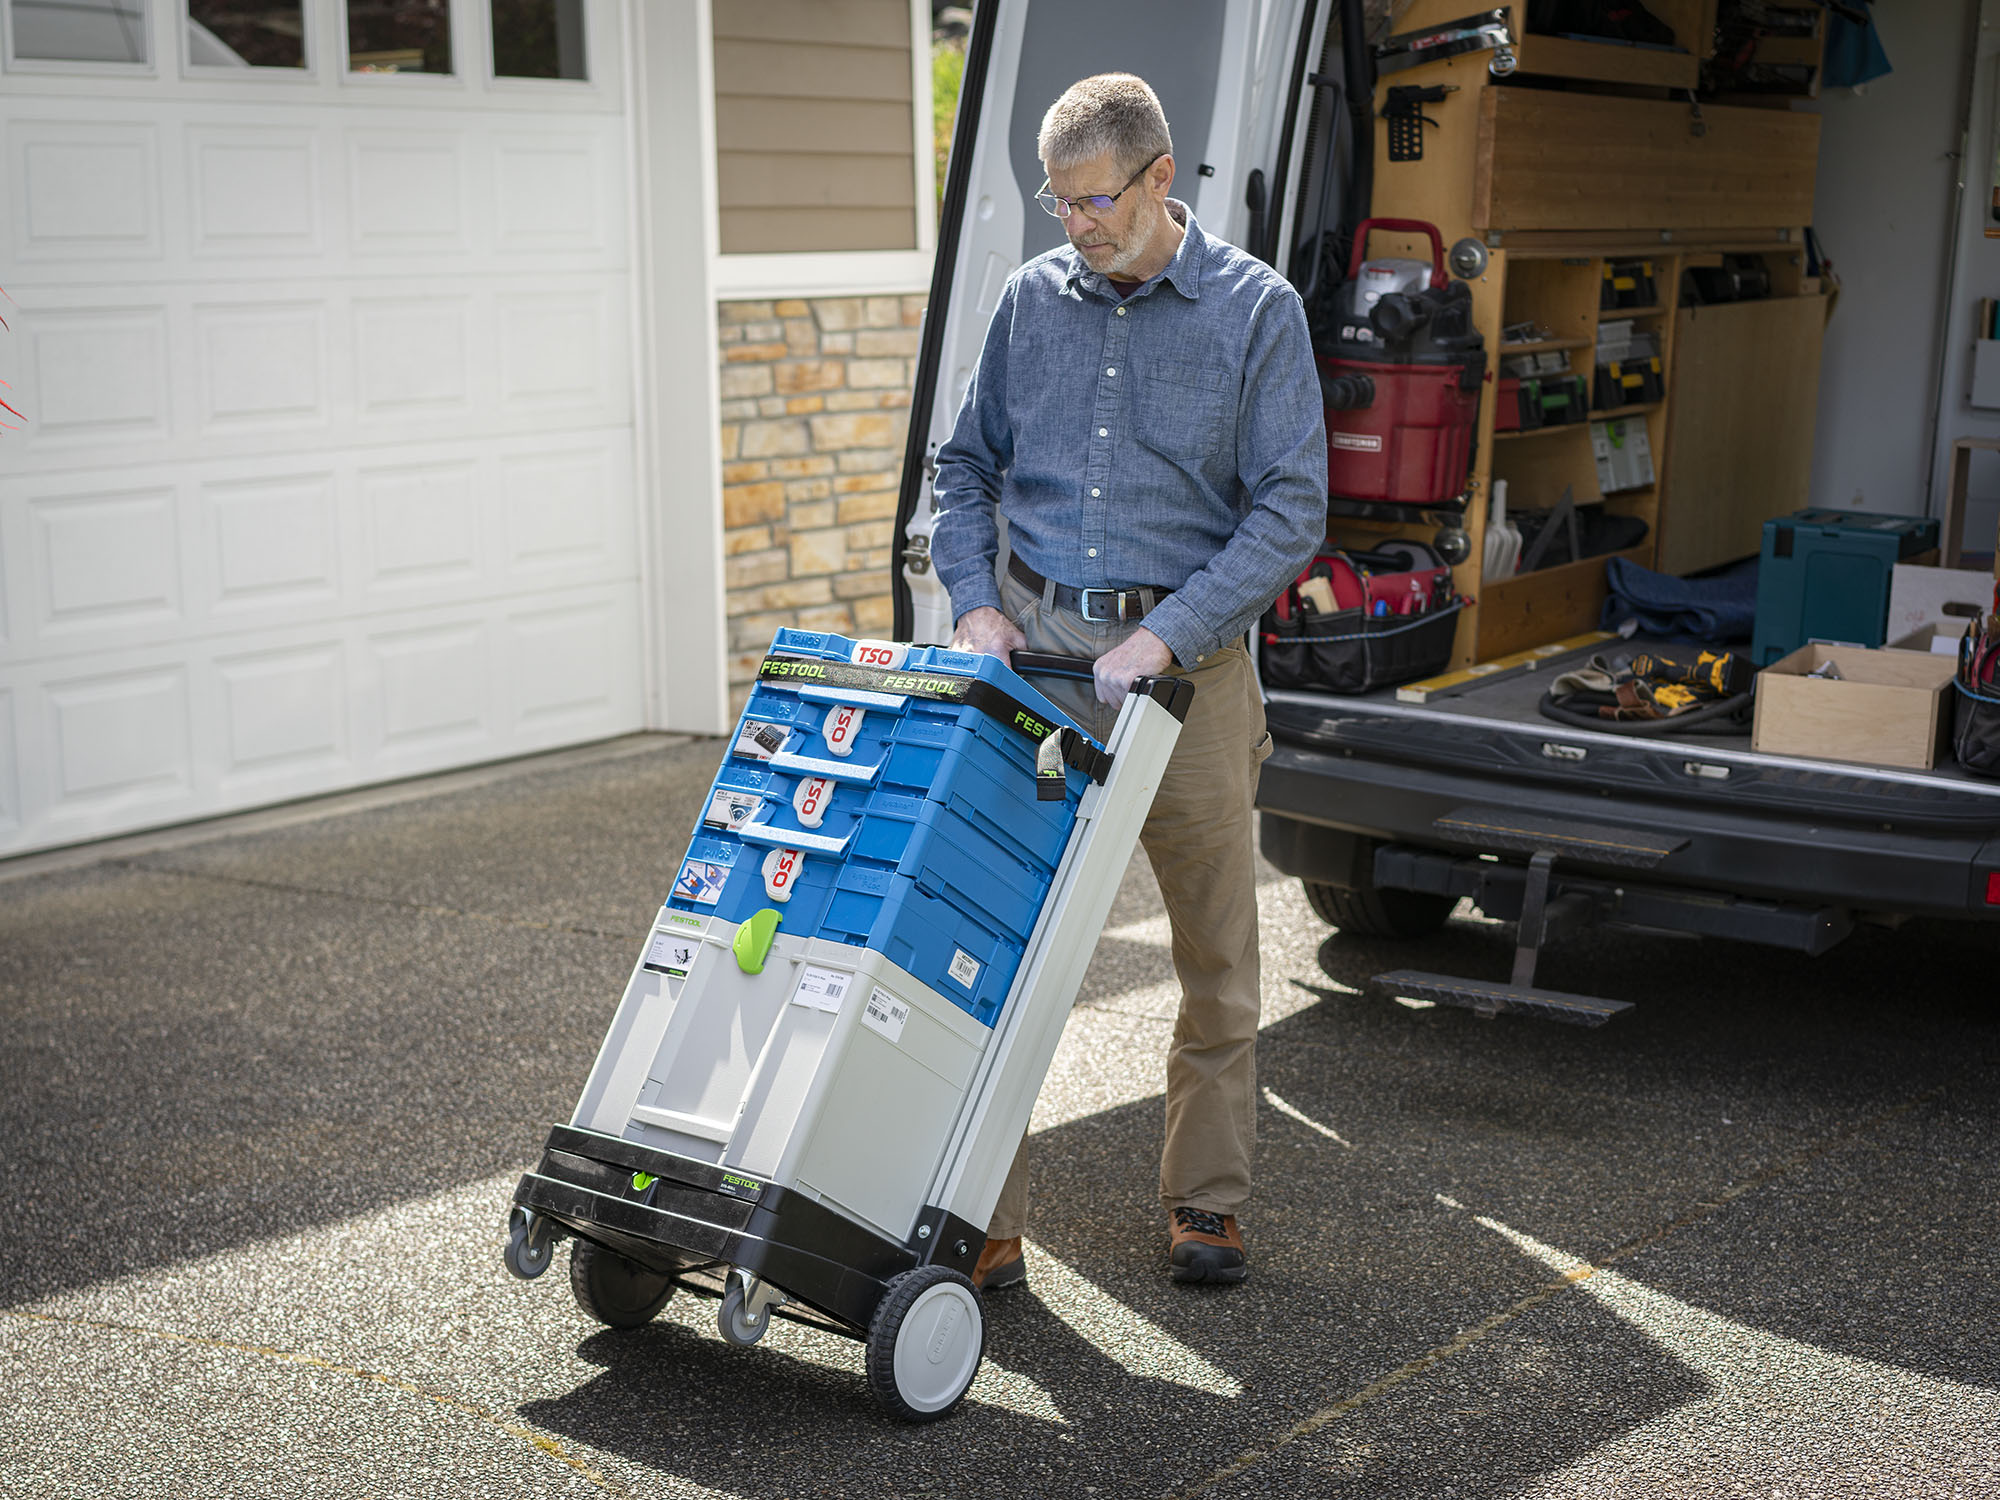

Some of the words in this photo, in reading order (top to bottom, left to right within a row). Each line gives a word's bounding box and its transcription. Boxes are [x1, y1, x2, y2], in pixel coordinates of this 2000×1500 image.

[859, 646, 893, 666] TSO
[760, 661, 827, 679] FESTOOL
[883, 676, 958, 696] FESTOOL
[831, 706, 856, 743] TSO
[1014, 711, 1053, 738] FEST
[801, 777, 827, 815] TSO
[772, 848, 799, 888] TSO
[670, 914, 702, 928] FESTOOL
[722, 1174, 761, 1191] FESTOOL
